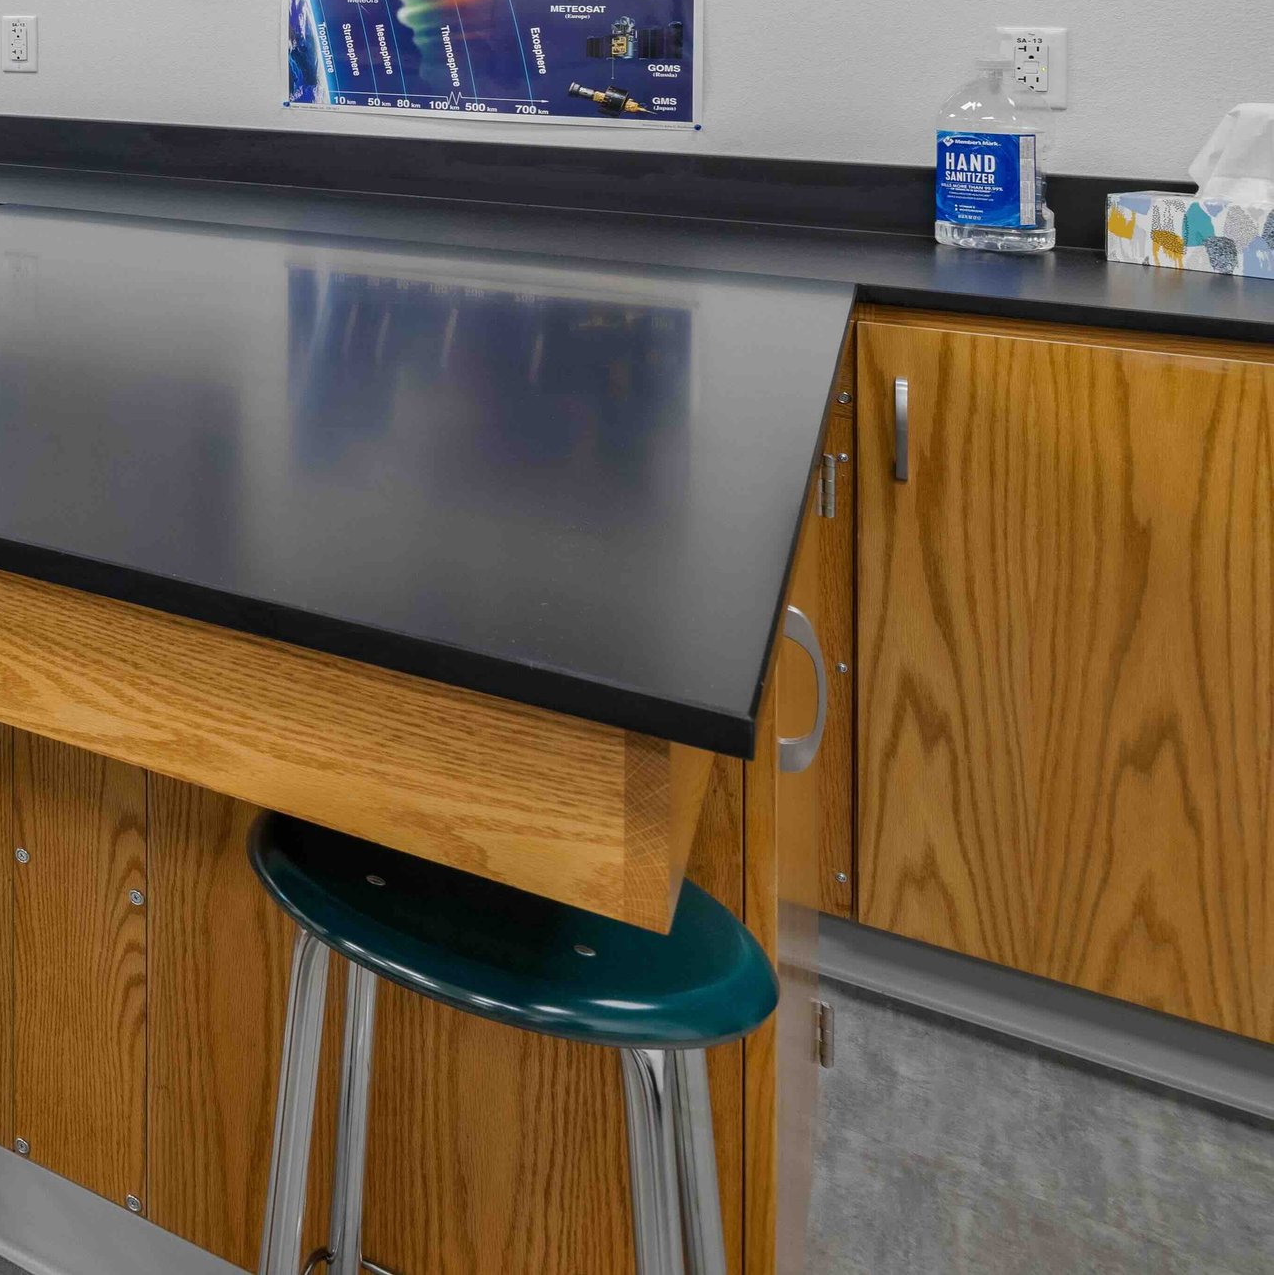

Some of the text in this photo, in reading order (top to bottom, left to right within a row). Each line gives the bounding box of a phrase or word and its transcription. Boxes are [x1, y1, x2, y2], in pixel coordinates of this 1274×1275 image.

[319, 22, 334, 73] Troposphere
[342, 24, 359, 76] Stratosphere
[375, 24, 393, 75] Mesosphere
[531, 27, 546, 75] Exosphere
[441, 25, 460, 87] Thermosphere
[648, 64, 681, 73] GOMS
[334, 97, 345, 105] 10
[368, 98, 380, 106] 50
[397, 99, 410, 108] 80
[429, 101, 448, 110] 100
[653, 97, 677, 106] GMS
[466, 103, 485, 112] 500
[515, 105, 536, 114] 700
[946, 152, 995, 172] HAND
[945, 171, 994, 184] SANITIZER
